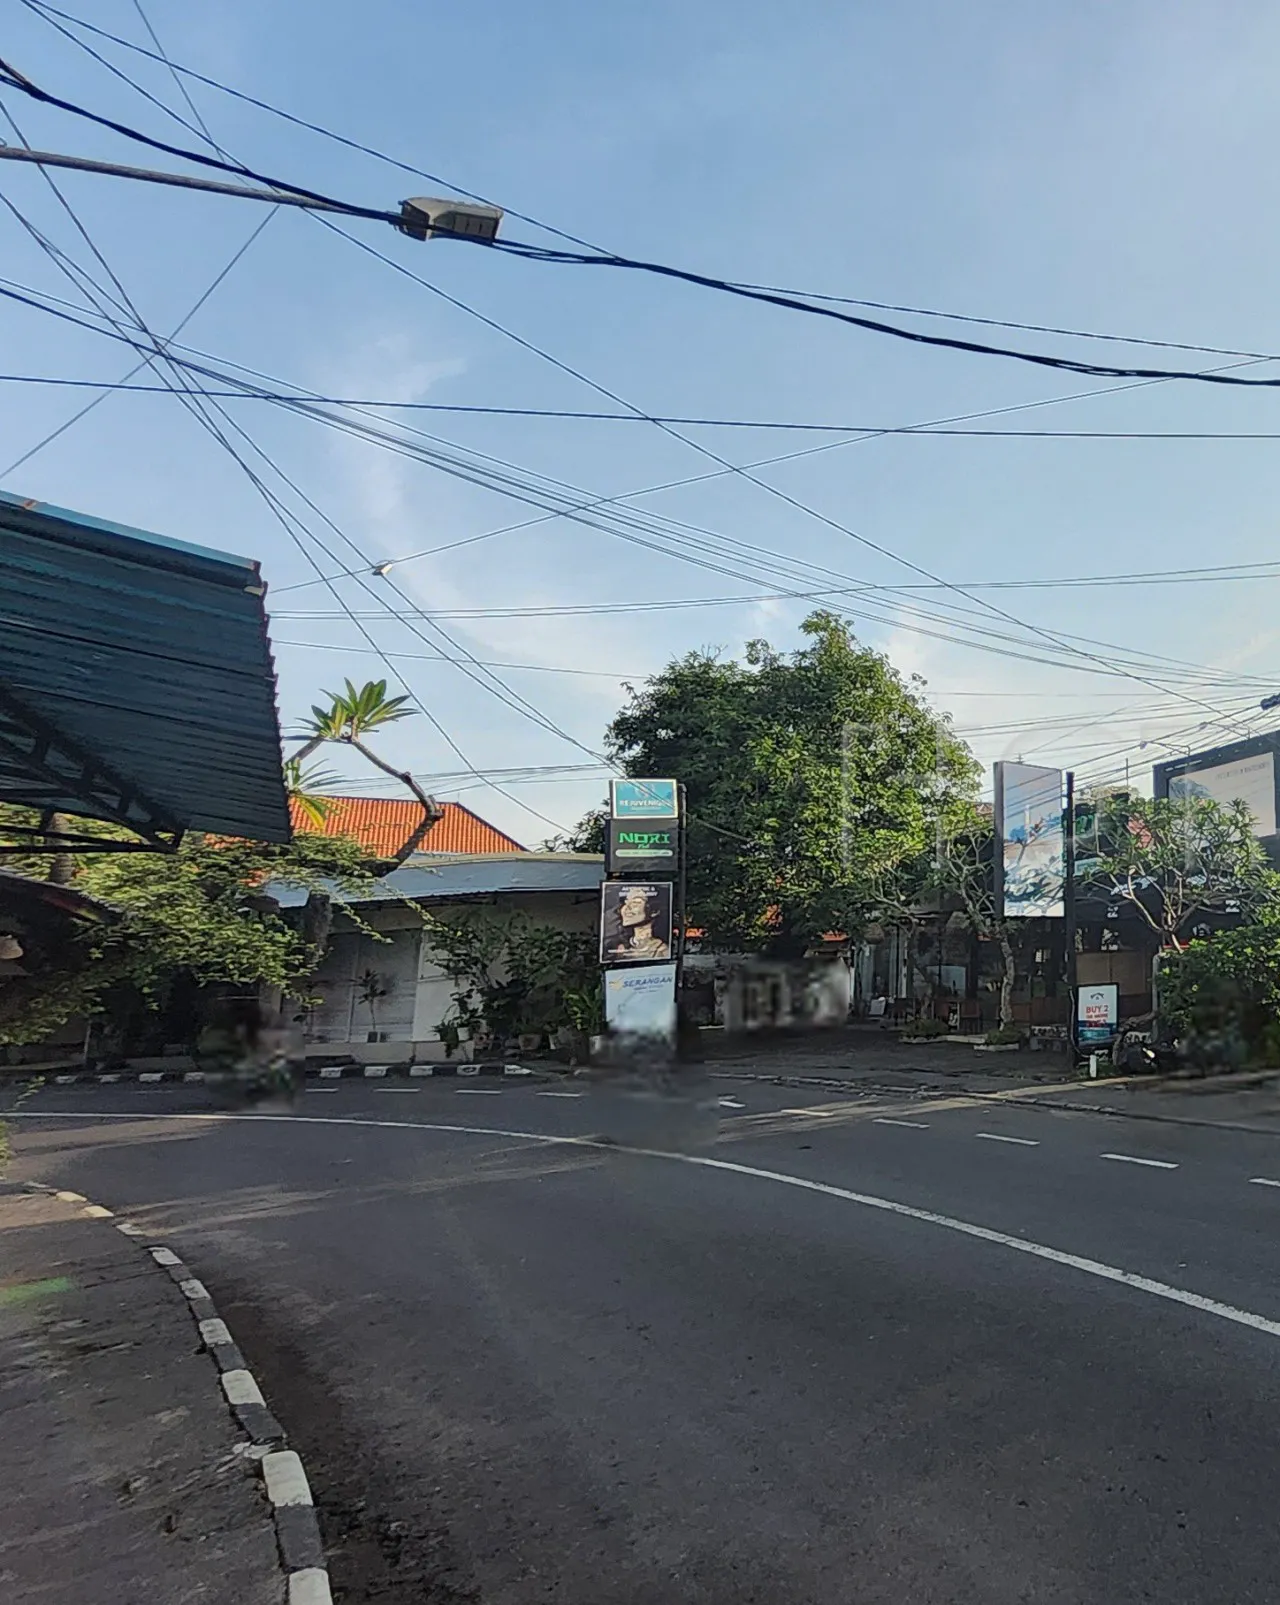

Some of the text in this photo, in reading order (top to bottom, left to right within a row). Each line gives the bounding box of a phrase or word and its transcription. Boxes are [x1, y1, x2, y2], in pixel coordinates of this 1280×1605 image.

[623, 977, 673, 988] SERANGAN
[1085, 1004, 1109, 1013] BUY 2
